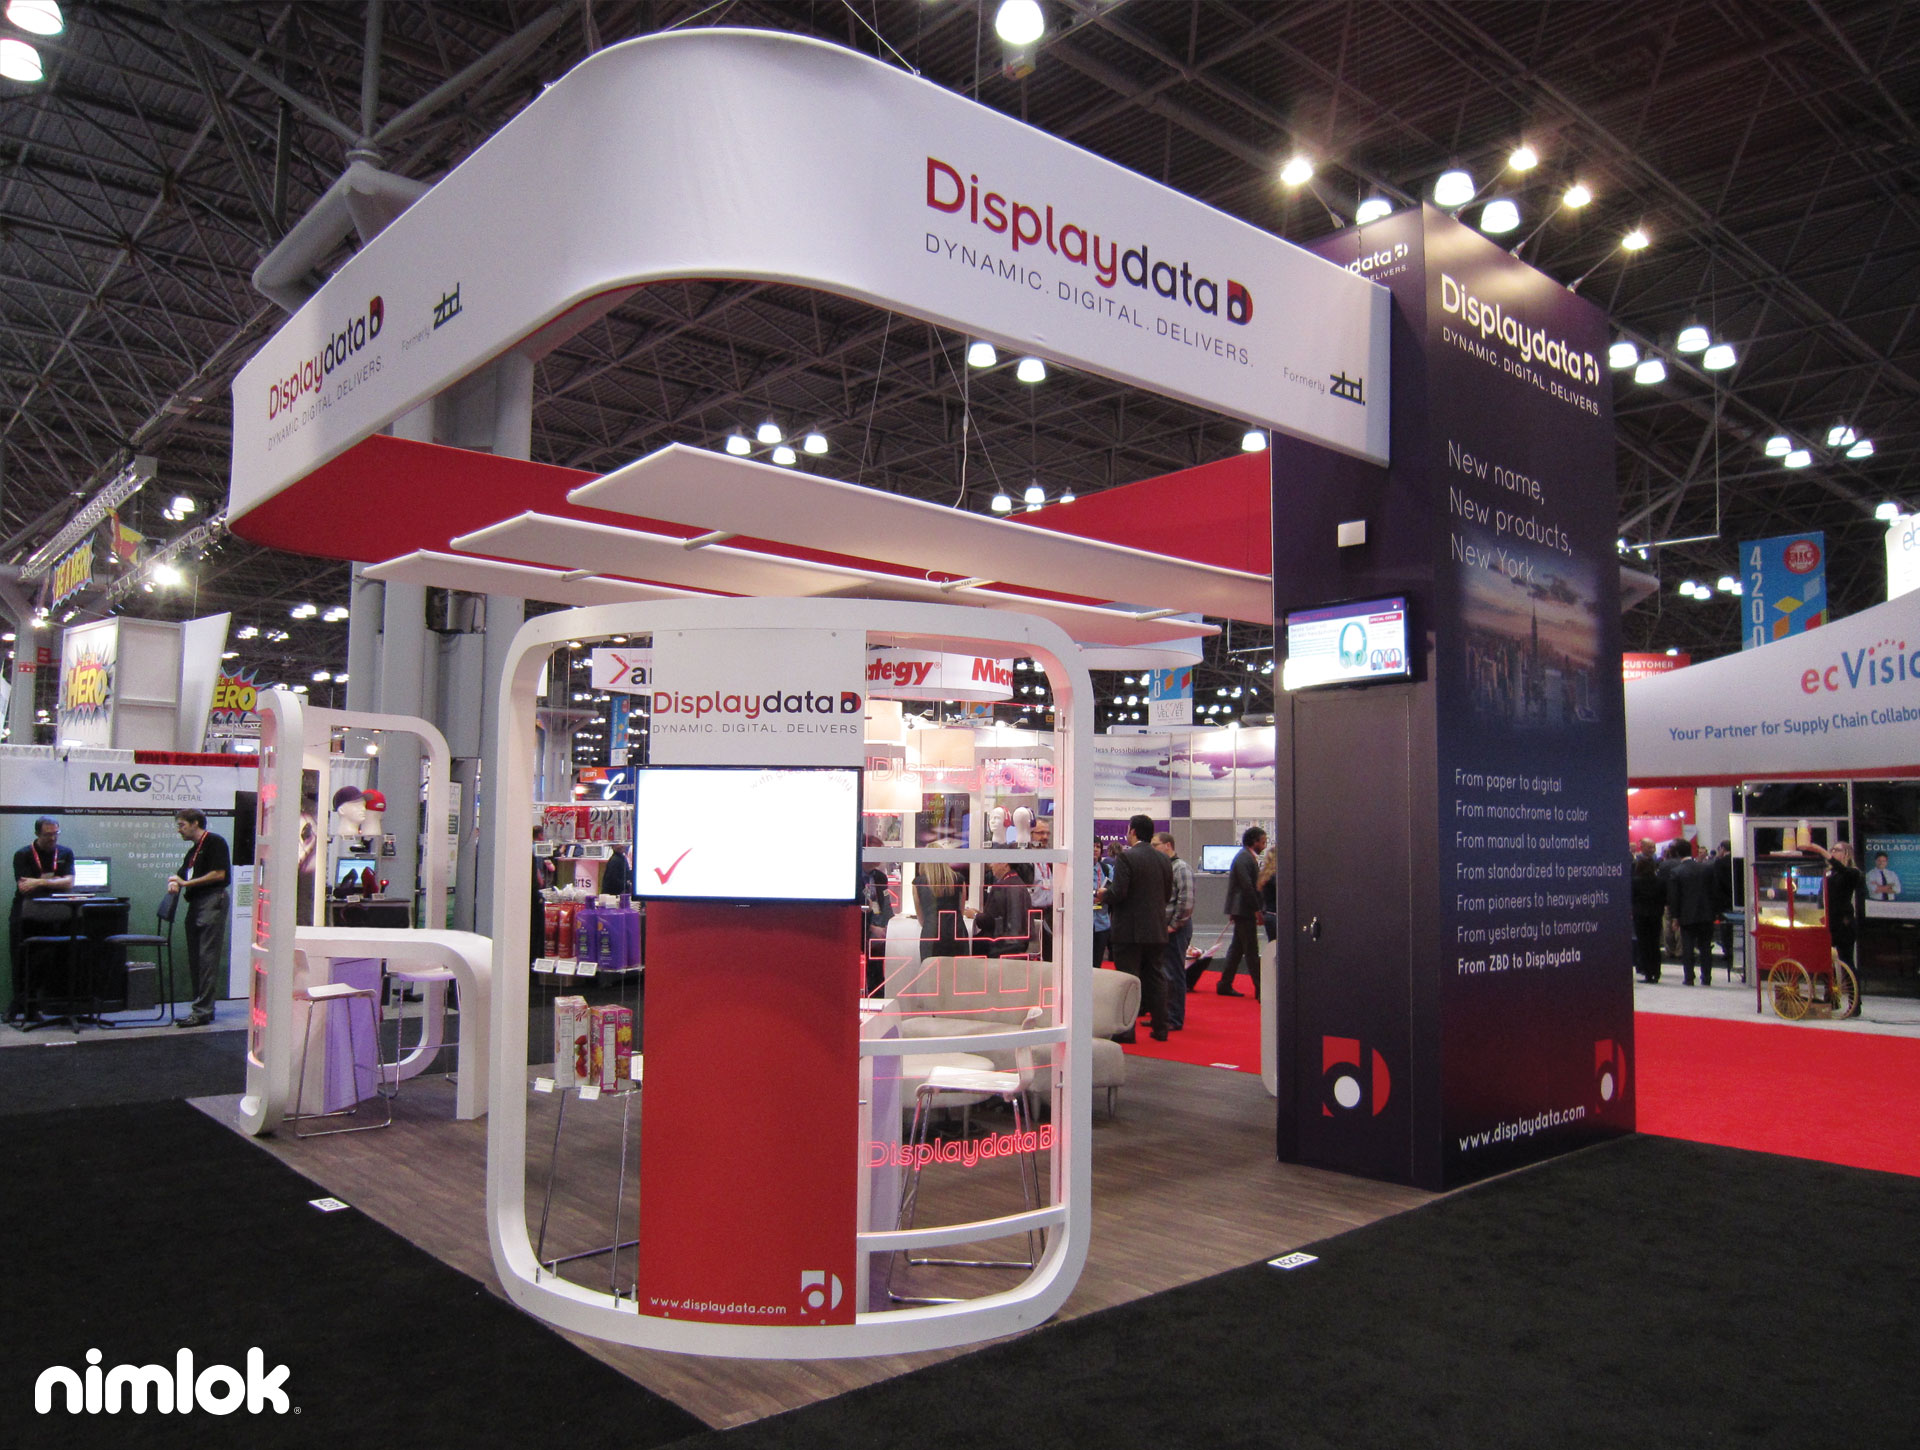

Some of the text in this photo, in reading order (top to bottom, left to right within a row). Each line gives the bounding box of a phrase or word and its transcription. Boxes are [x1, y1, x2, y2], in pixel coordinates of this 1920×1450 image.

[927, 156, 1218, 316] Displaydata
[925, 233, 1254, 368] DYNAMIC. DIGITAL. DELIVERS.
[1441, 273, 1582, 384] Displaydata
[268, 315, 367, 421] Displaydata
[1282, 366, 1326, 395] Formerly
[1443, 326, 1602, 417] DYNAMIC. DIGITAL. DELIVERS.
[1447, 440, 1545, 505] New name,
[1449, 486, 1573, 557] New products,
[1450, 533, 1535, 583] New York
[1623, 660, 1674, 669] CUSTOMER
[66, 665, 108, 712] HERO
[212, 685, 257, 711] ERO
[653, 690, 834, 719] Displaydata
[786, 723, 858, 735] DELIVERS
[1669, 726, 1701, 742] Your
[1704, 723, 1757, 740] Partner
[1761, 720, 1780, 736] for
[1783, 716, 1829, 735] Supply
[1832, 711, 1868, 730] Chain
[89, 772, 204, 794] MAGSTAR
[1455, 768, 1562, 796] From paper to digital
[152, 793, 203, 803] TOTAL RETAIL
[1456, 800, 1589, 822] From monochrome to color
[1456, 831, 1590, 850] From manual to automated
[1456, 861, 1623, 881] From standardized to personalized
[1457, 889, 1609, 914] From pioneers to heavyweights
[1457, 920, 1598, 945] From yesterday to tomorrow
[1458, 947, 1581, 975] From ZBD to Displaydata
[1459, 1104, 1585, 1152] www.displaydata.com
[865, 1127, 1037, 1172] Displaydata
[650, 1296, 787, 1315] www.displaydata.com
